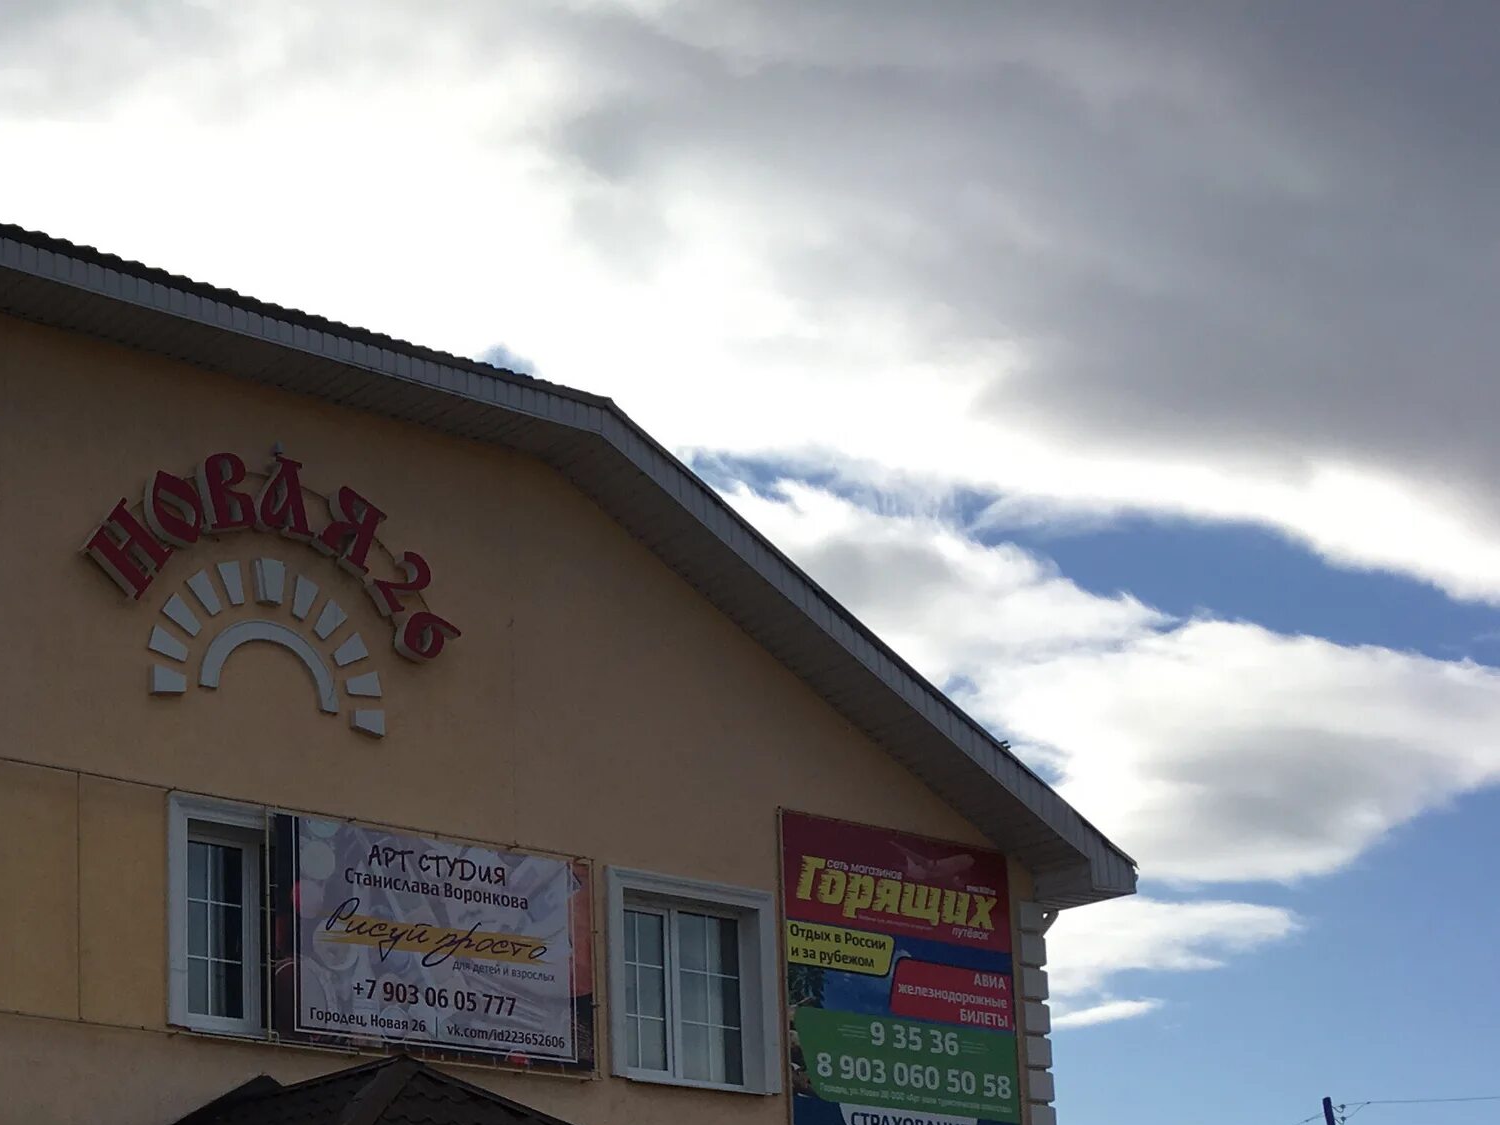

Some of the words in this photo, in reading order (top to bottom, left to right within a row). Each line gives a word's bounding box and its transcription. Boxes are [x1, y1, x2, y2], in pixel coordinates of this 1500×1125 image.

[83, 452, 387, 600] НОВАЯ
[366, 551, 462, 660] 26
[368, 845, 414, 870] АРТ
[418, 852, 506, 886] СТУДИЯ
[826, 859, 849, 871] сеть
[850, 862, 903, 880] магазинов
[344, 868, 440, 897] Станислава
[443, 883, 529, 910] Воронкова
[796, 855, 998, 930] Горящих
[326, 898, 430, 962] Рисуй
[422, 922, 548, 967] просто
[790, 923, 831, 941] Отдых
[834, 933, 842, 943] в
[845, 933, 887, 951] России
[452, 960, 471, 972] для
[472, 963, 501, 975] детей
[502, 967, 509, 975] и
[511, 969, 556, 983] взрослых
[791, 946, 800, 956] и
[802, 949, 816, 959] за
[819, 950, 875, 969] рубежом
[898, 982, 1008, 1009] железнодорожные
[973, 973, 1006, 990] АВИА
[353, 979, 376, 1000] +7
[383, 982, 419, 1004] 903
[425, 987, 448, 1008] 06
[454, 991, 477, 1012] 05
[482, 994, 516, 1017] 777
[309, 1007, 367, 1028] Городец,
[370, 1015, 409, 1030] Новая
[411, 1018, 426, 1032] 26
[960, 1008, 1008, 1028] БИЛЕТЫ
[446, 1023, 565, 1049] vk.com/id223652606
[870, 1022, 885, 1045] 9
[893, 1026, 921, 1051] 35
[930, 1031, 959, 1056] 36
[817, 1052, 832, 1077] 8
[839, 1055, 886, 1083] 903
[893, 1062, 940, 1090] 060
[947, 1070, 976, 1095] 50
[983, 1074, 1012, 1099] 58
